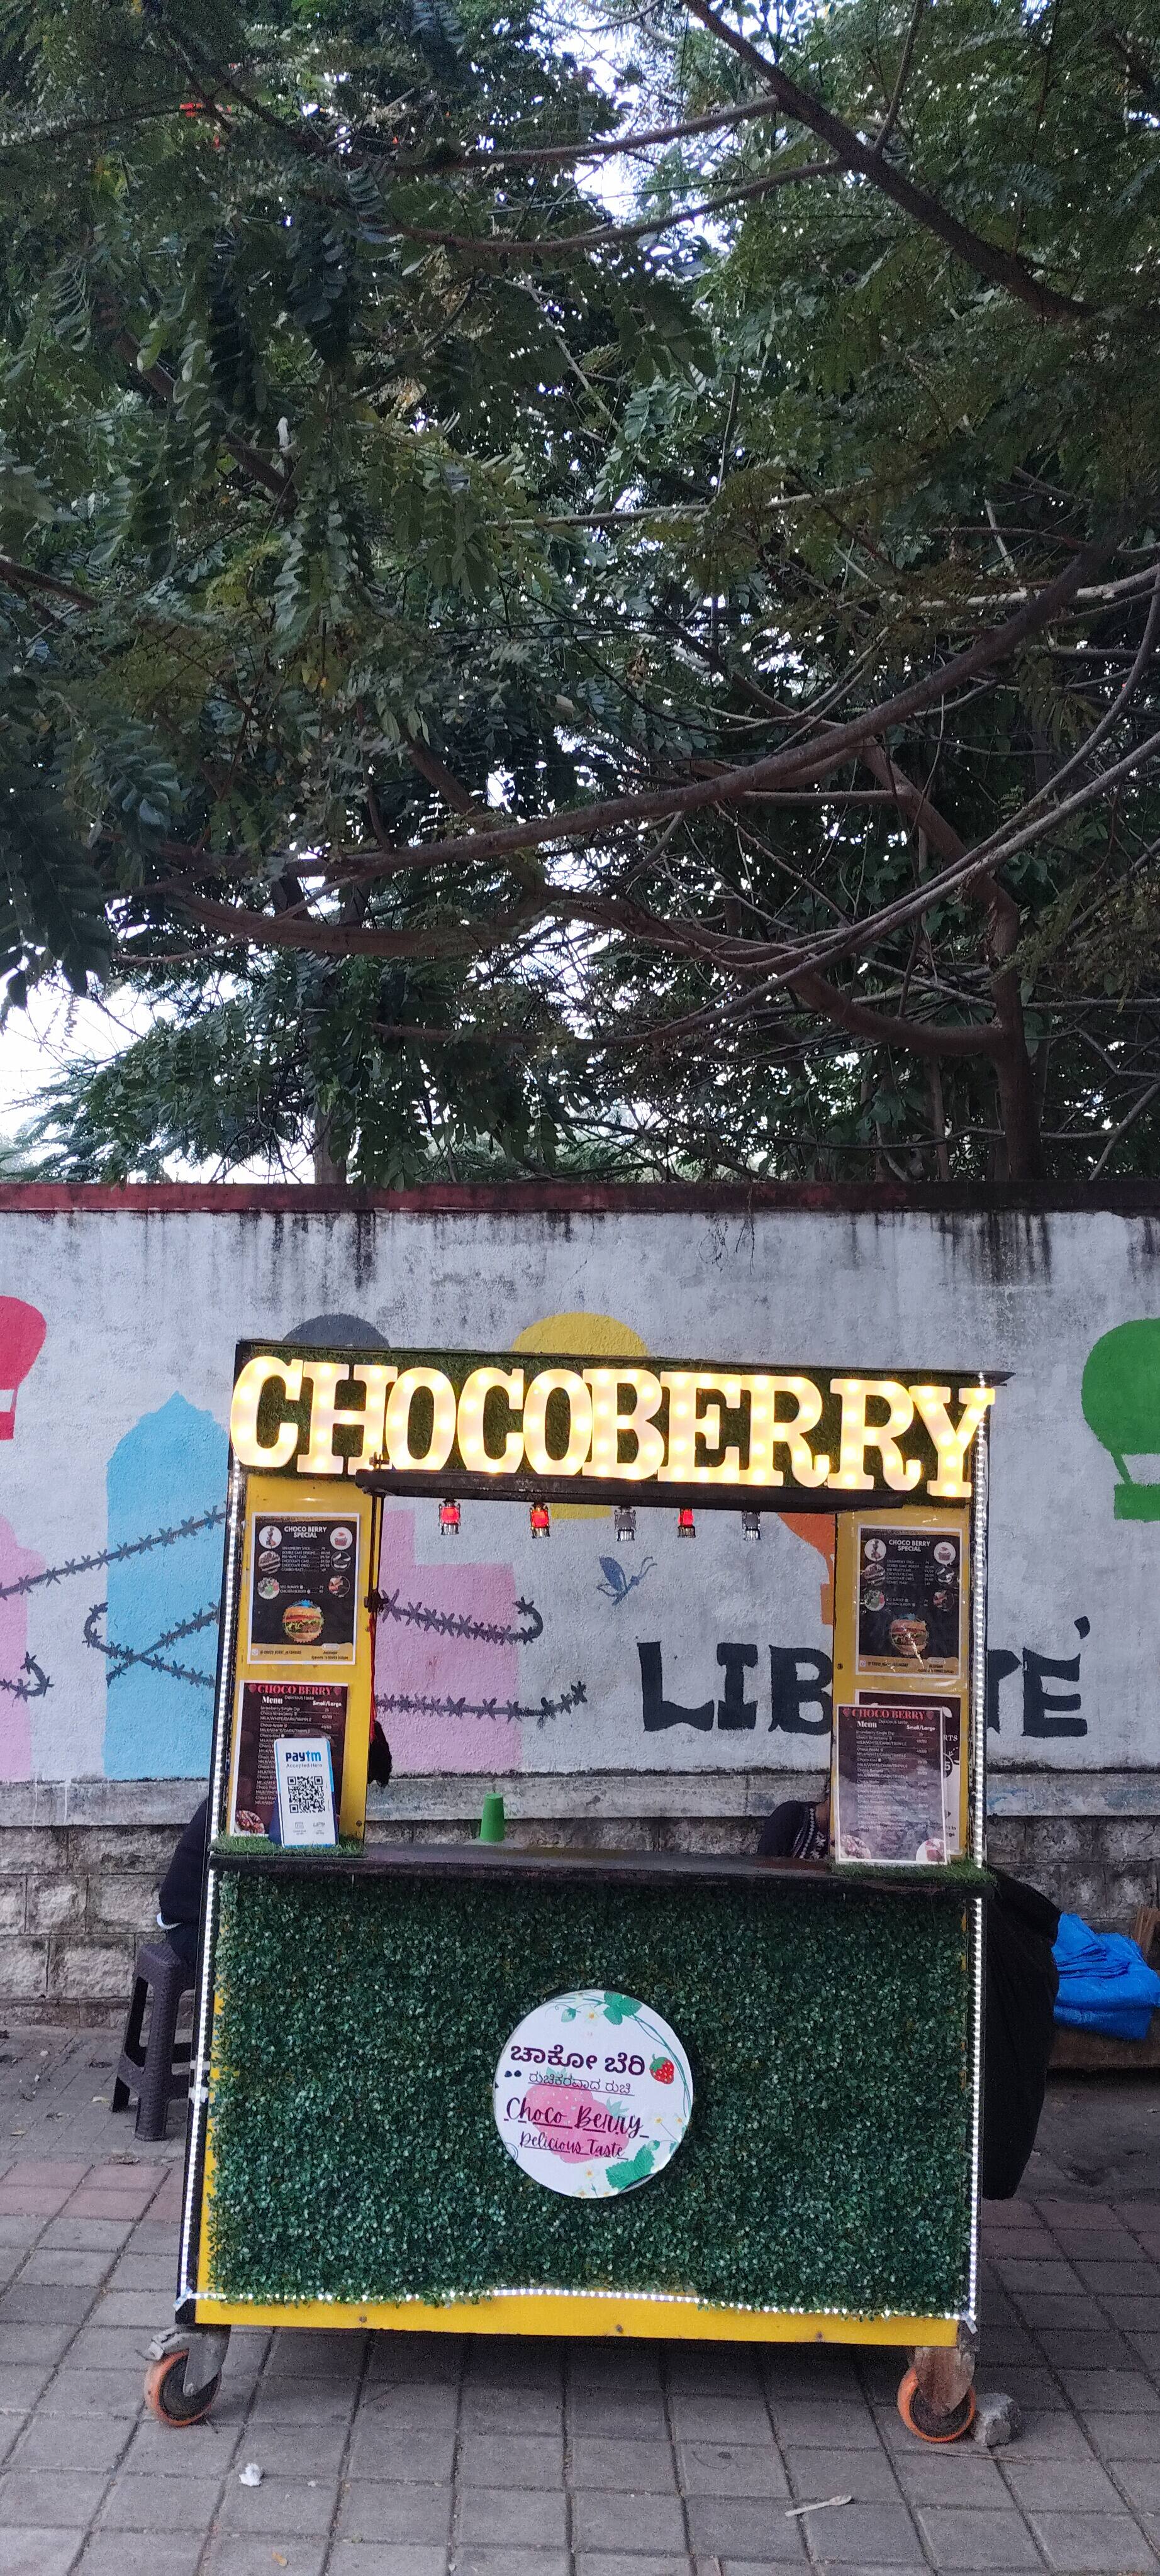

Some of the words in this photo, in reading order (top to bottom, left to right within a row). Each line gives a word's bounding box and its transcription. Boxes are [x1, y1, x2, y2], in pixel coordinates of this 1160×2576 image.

[230, 1355, 995, 1497] CHOCOBERRY
[257, 1684, 296, 1694] CHOCO
[298, 1686, 332, 1696] BERRY
[637, 1616, 1090, 1738] LIBÉ
[262, 1696, 283, 1704] Menu
[852, 1708, 890, 1719] CHOCO
[892, 1710, 925, 1720] BERRY
[510, 2044, 598, 2070] ಚಾಕೋ
[605, 2052, 645, 2076] ಬೆರಿ
[528, 2071, 601, 2090] ರುಚಿಕರವಾದ
[605, 2080, 631, 2094] ರುಚಿ
[506, 2097, 566, 2124] Choco
[573, 2105, 643, 2138] Berry
[519, 2131, 582, 2154] Delicious
[587, 2138, 626, 2158] Taste
